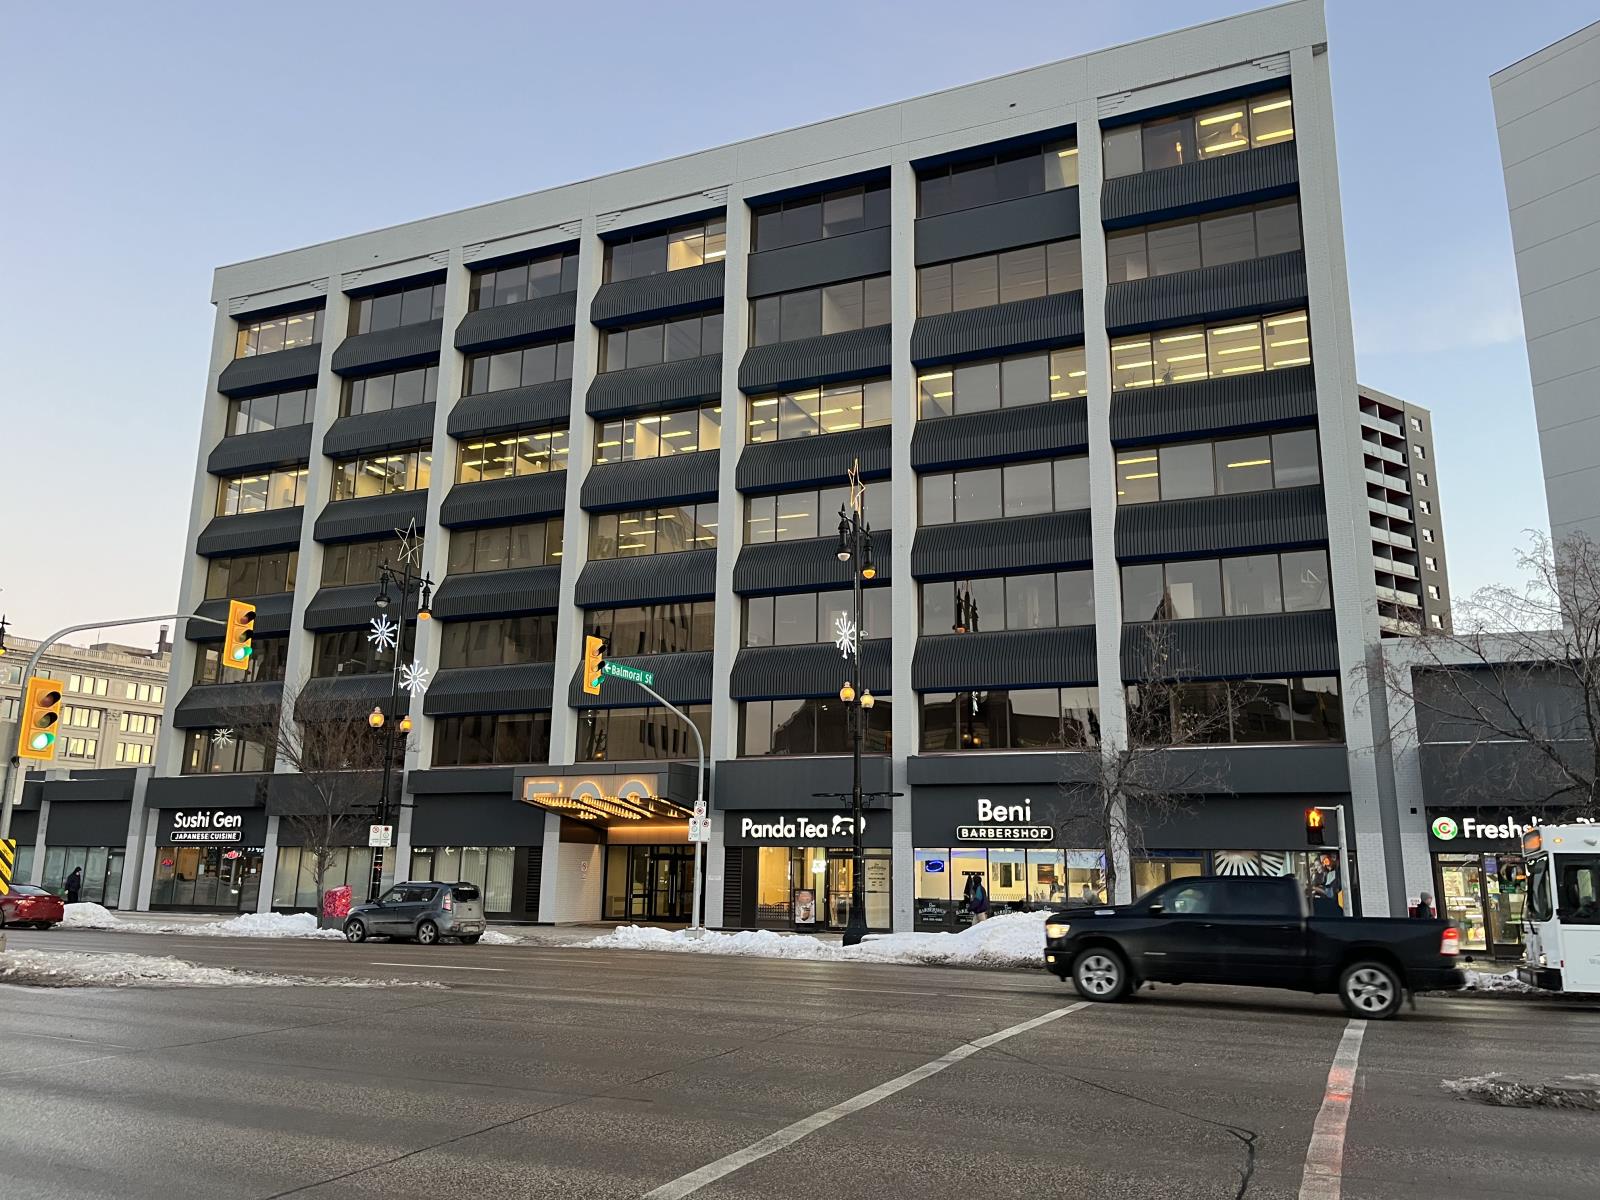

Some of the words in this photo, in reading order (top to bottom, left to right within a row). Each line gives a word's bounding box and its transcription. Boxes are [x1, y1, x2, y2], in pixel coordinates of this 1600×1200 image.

[611, 664, 642, 682] Balmoral
[644, 674, 652, 684] St
[977, 798, 1031, 822] Beni
[173, 811, 210, 828] Sushi
[213, 811, 242, 828] Gen
[741, 815, 795, 838] Panda
[797, 817, 827, 838] Tea
[210, 832, 237, 840] CUISINE
[961, 828, 1048, 839] BARBERSHOP
